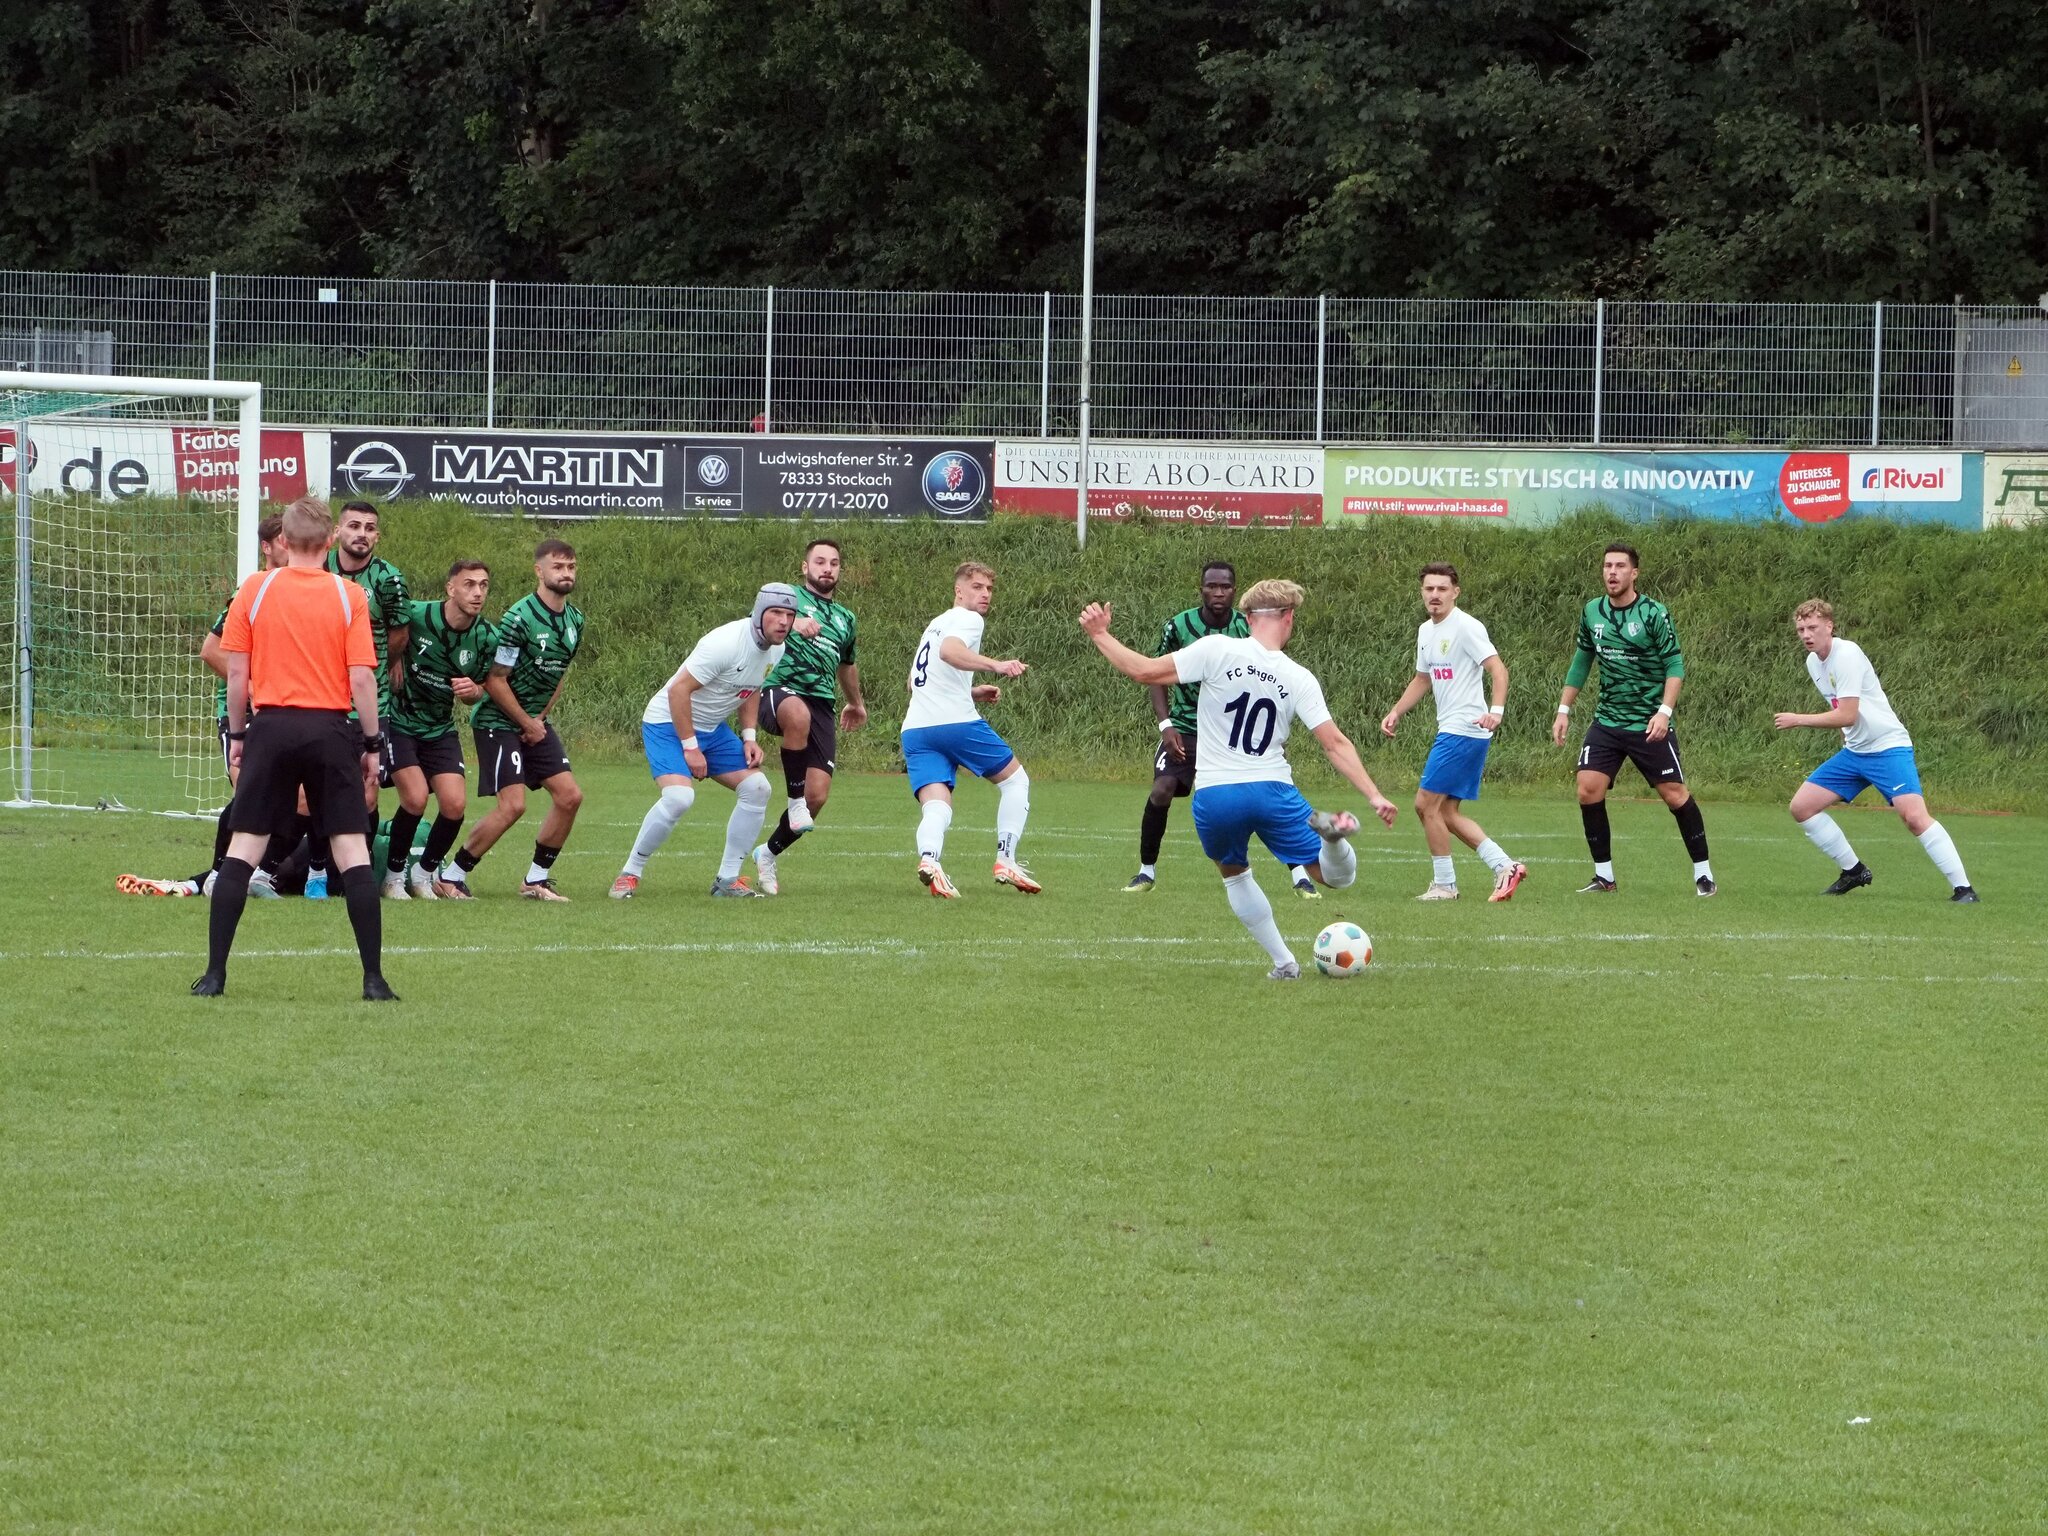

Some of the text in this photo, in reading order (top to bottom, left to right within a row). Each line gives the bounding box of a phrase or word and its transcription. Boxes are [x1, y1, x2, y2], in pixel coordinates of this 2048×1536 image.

[759, 452, 913, 468] Ludwigshafener Str. 2
[1005, 448, 1024, 456] DIE
[1195, 451, 1221, 460] IHRE
[1228, 452, 1314, 463] MITTAGSPAUSE
[183, 457, 298, 478] Dämung
[431, 444, 664, 487] MARTIN
[1789, 467, 1832, 480] INTERESSE
[779, 471, 892, 486] 78333 Stockach
[1144, 463, 1315, 488] ABO-CARD
[1345, 466, 1755, 490] PRODUKTE: STYLISCH & INNOVATIV
[1884, 468, 1944, 489] Rival
[190, 485, 269, 503] Ausbu
[1787, 479, 1840, 493] ZU SCHAUEN?
[429, 490, 663, 508] www.autohaus-martin.com
[695, 496, 732, 506] Service
[782, 493, 888, 509] 07771-2070
[935, 492, 970, 501] SAAB
[1793, 493, 1841, 505] Online stöbern!
[1086, 502, 1112, 517] um
[1407, 502, 1503, 512] www.rival-haas.de
[1594, 628, 1603, 639] 21
[540, 639, 546, 652] 9
[914, 641, 930, 688] 9
[1226, 667, 1243, 681] FC
[1224, 692, 1277, 757] 10
[511, 751, 522, 775] 9
[1156, 752, 1167, 770] 4
